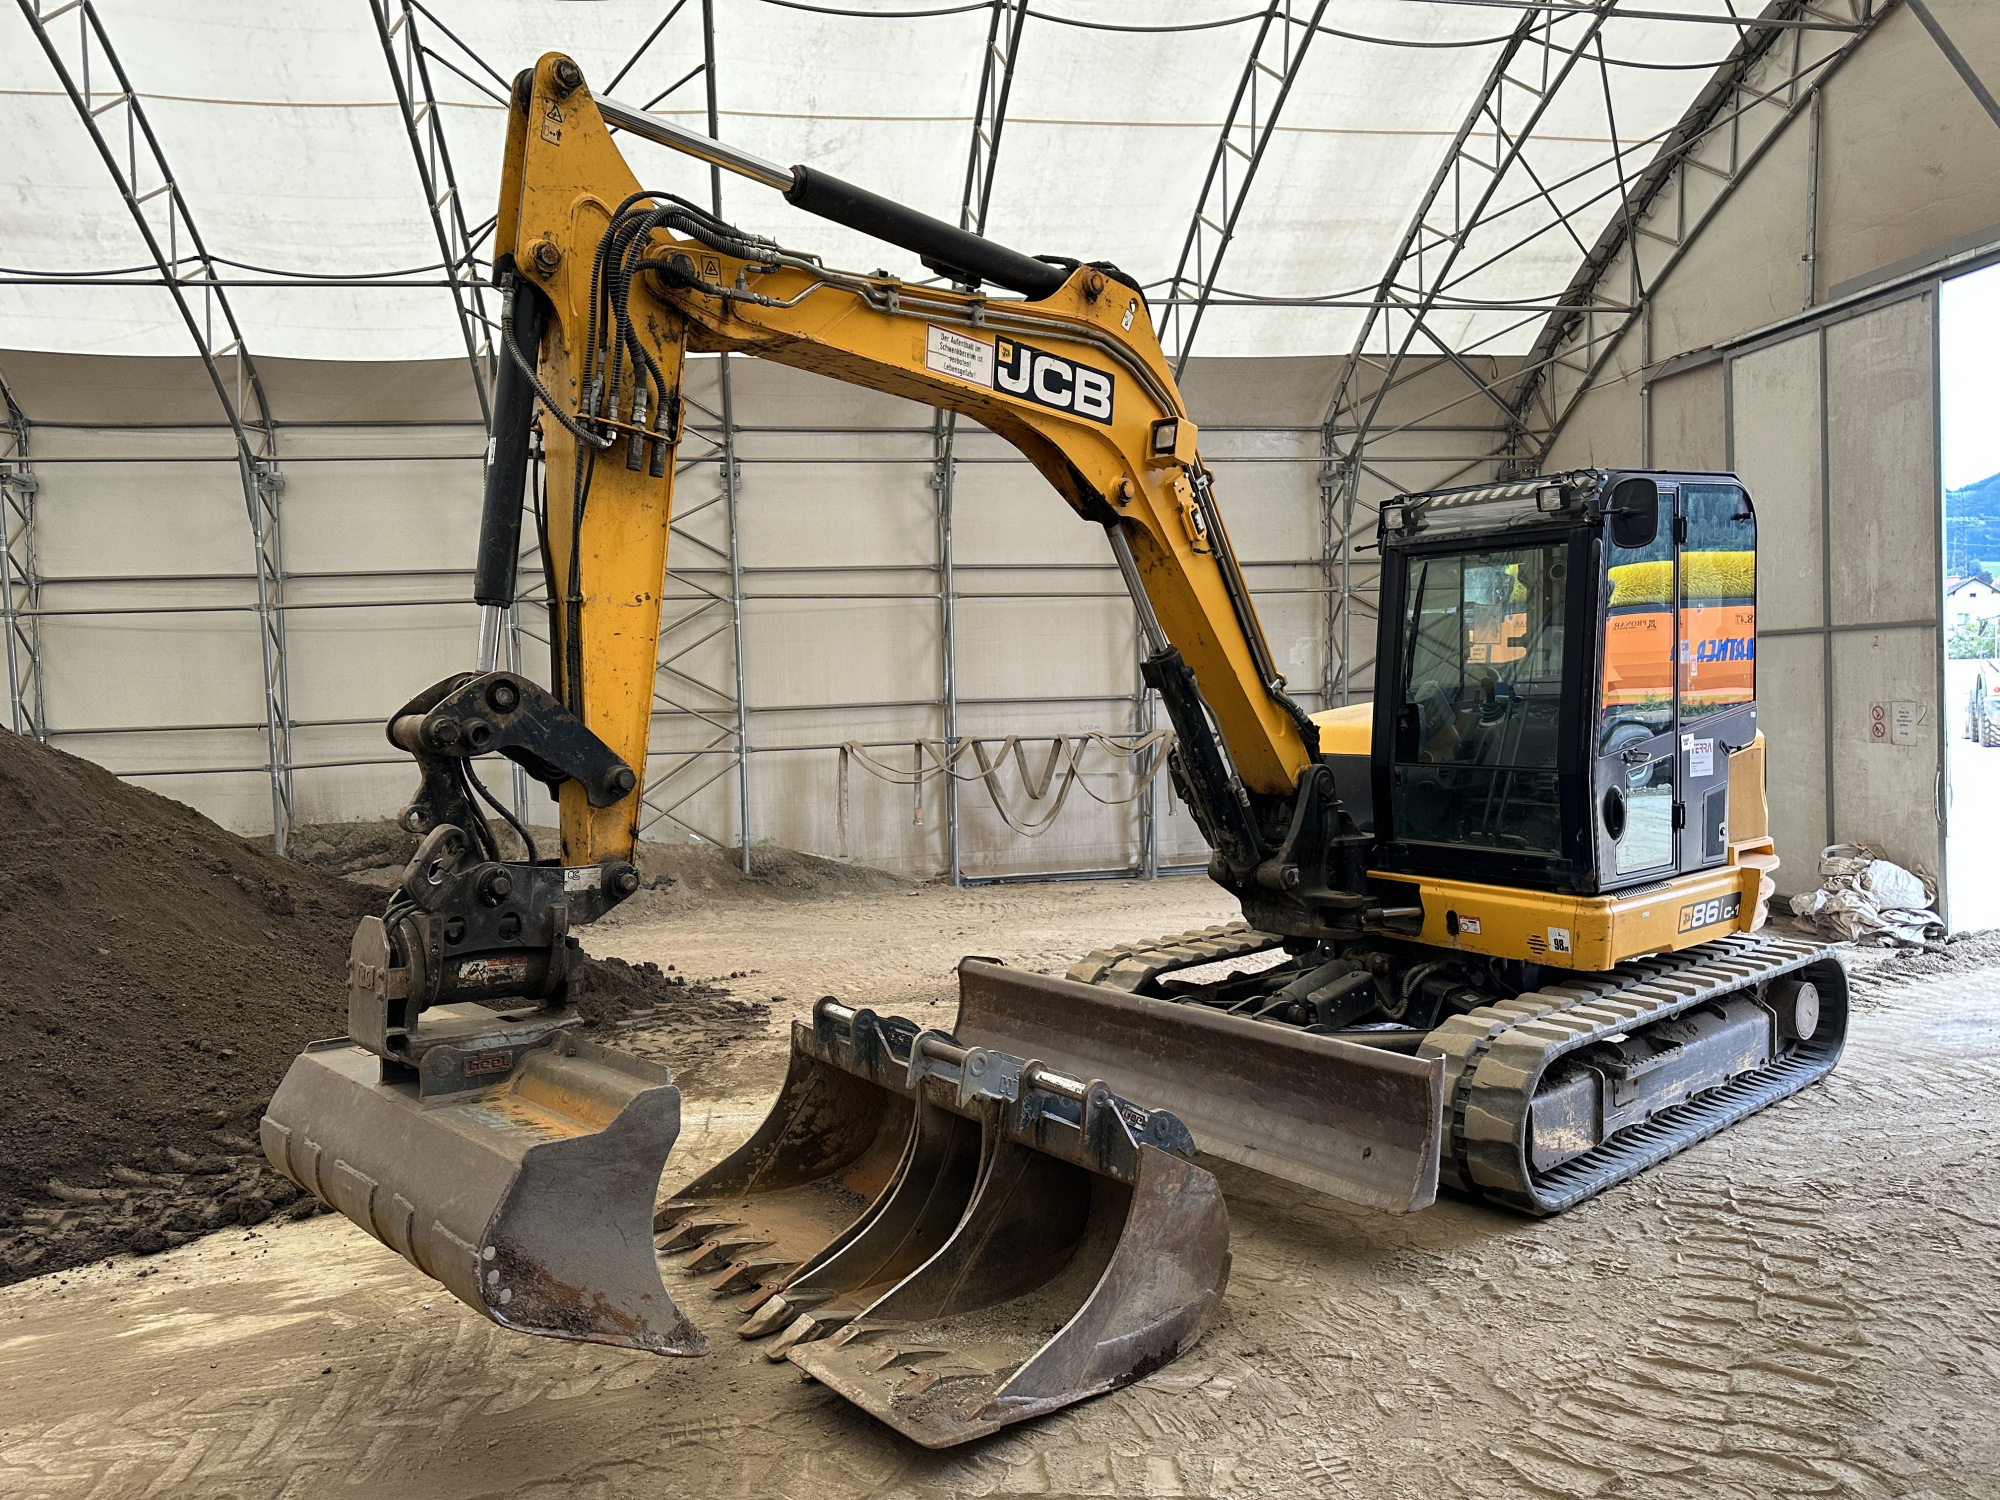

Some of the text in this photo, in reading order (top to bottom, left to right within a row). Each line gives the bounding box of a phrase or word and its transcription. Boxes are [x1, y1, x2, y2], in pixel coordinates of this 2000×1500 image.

[941, 333, 949, 341] Der
[951, 336, 974, 350] Aufenthalt
[940, 342, 976, 360] Schwenkbereich
[944, 362, 976, 378] Lebensgefahr!
[950, 356, 971, 368] verboten!
[998, 348, 1111, 419] JCB
[1692, 900, 1719, 927] 86
